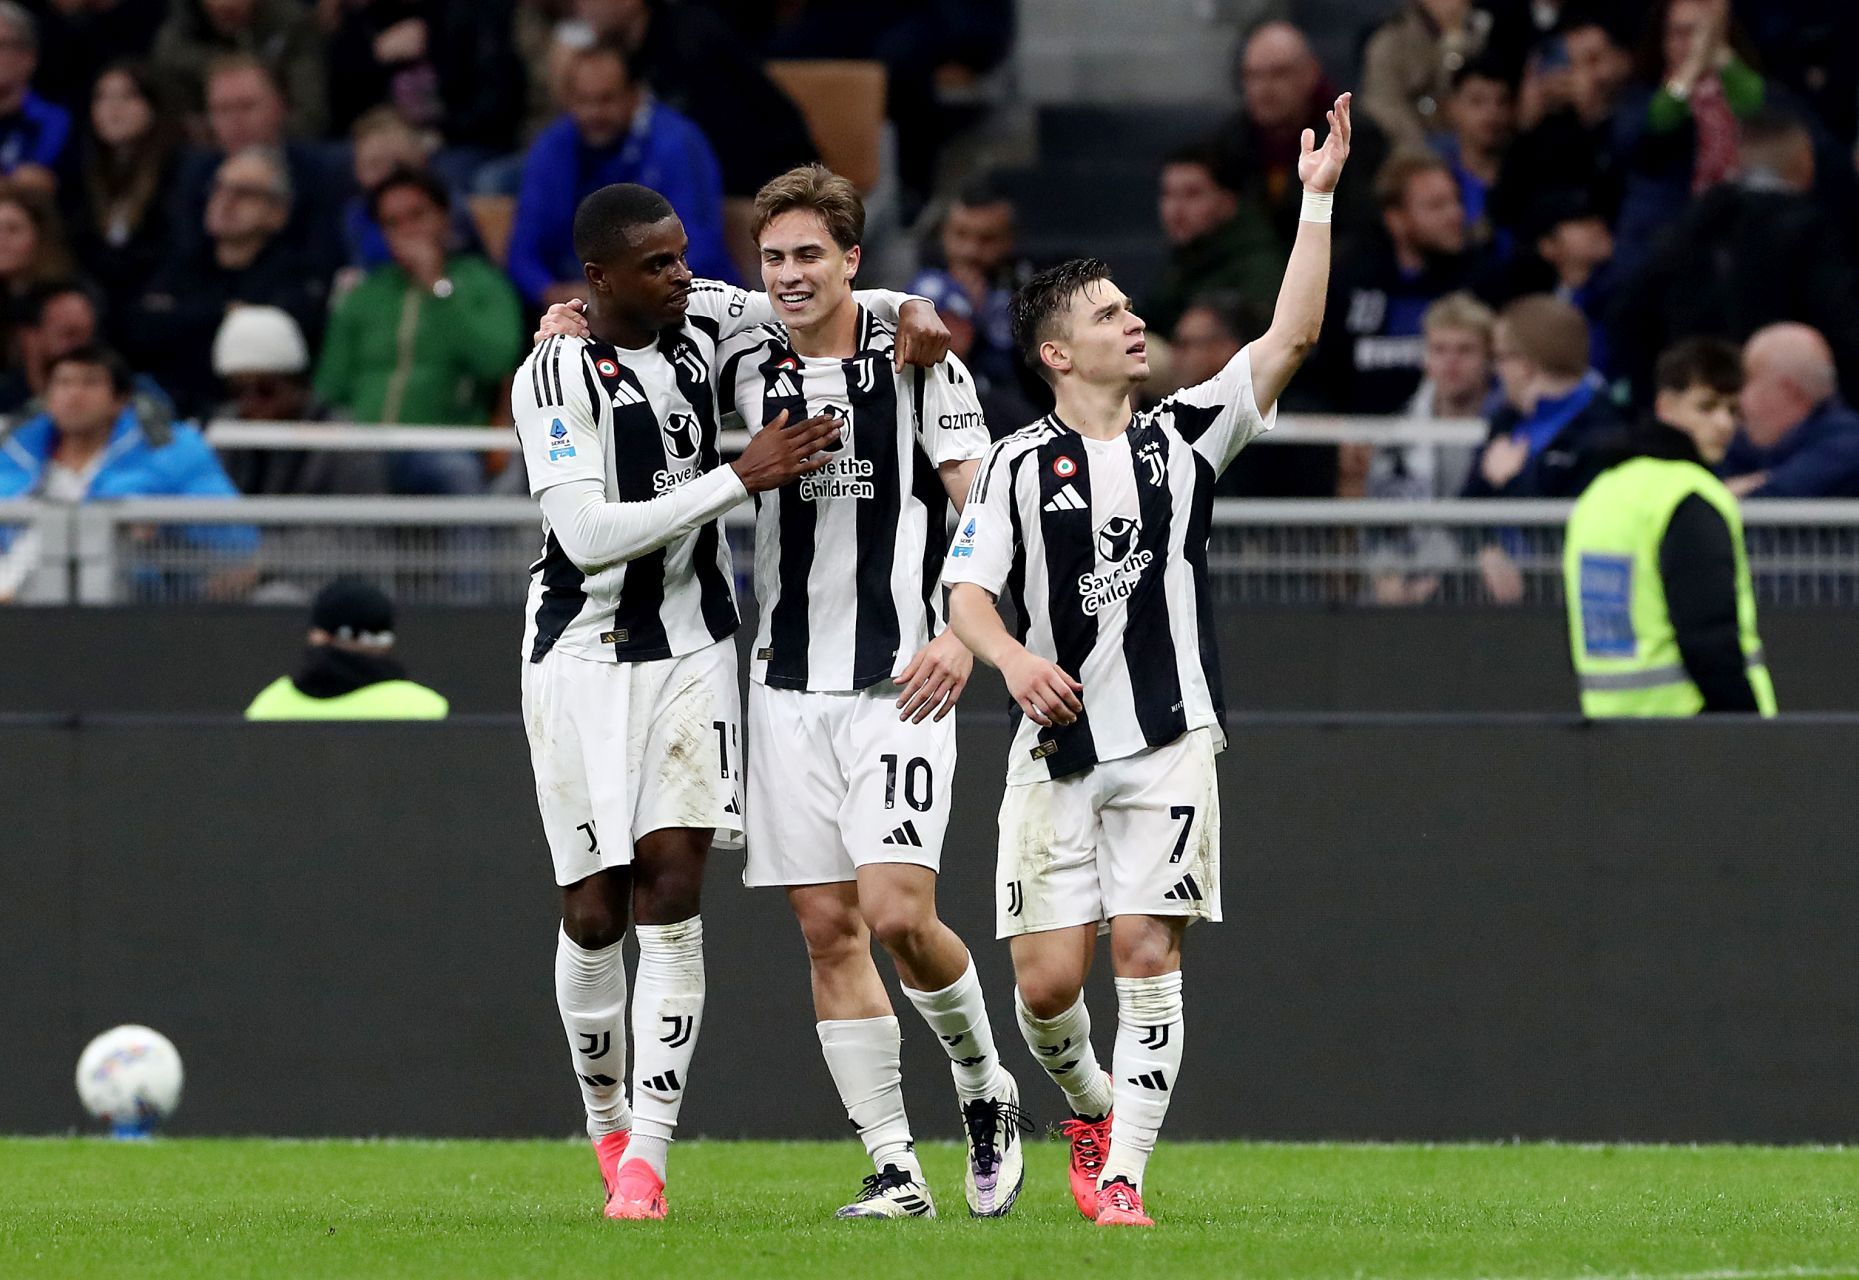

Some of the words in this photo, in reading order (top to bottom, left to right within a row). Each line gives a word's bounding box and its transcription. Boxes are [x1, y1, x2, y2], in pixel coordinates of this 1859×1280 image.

[654, 468, 692, 490] Save
[839, 458, 872, 475] the
[801, 480, 873, 500] Children
[1080, 568, 1121, 593] Save
[1123, 552, 1152, 573] the
[1084, 580, 1136, 613] Childr
[713, 721, 739, 779] 1
[880, 754, 933, 812] 10
[1169, 806, 1195, 863] 7
